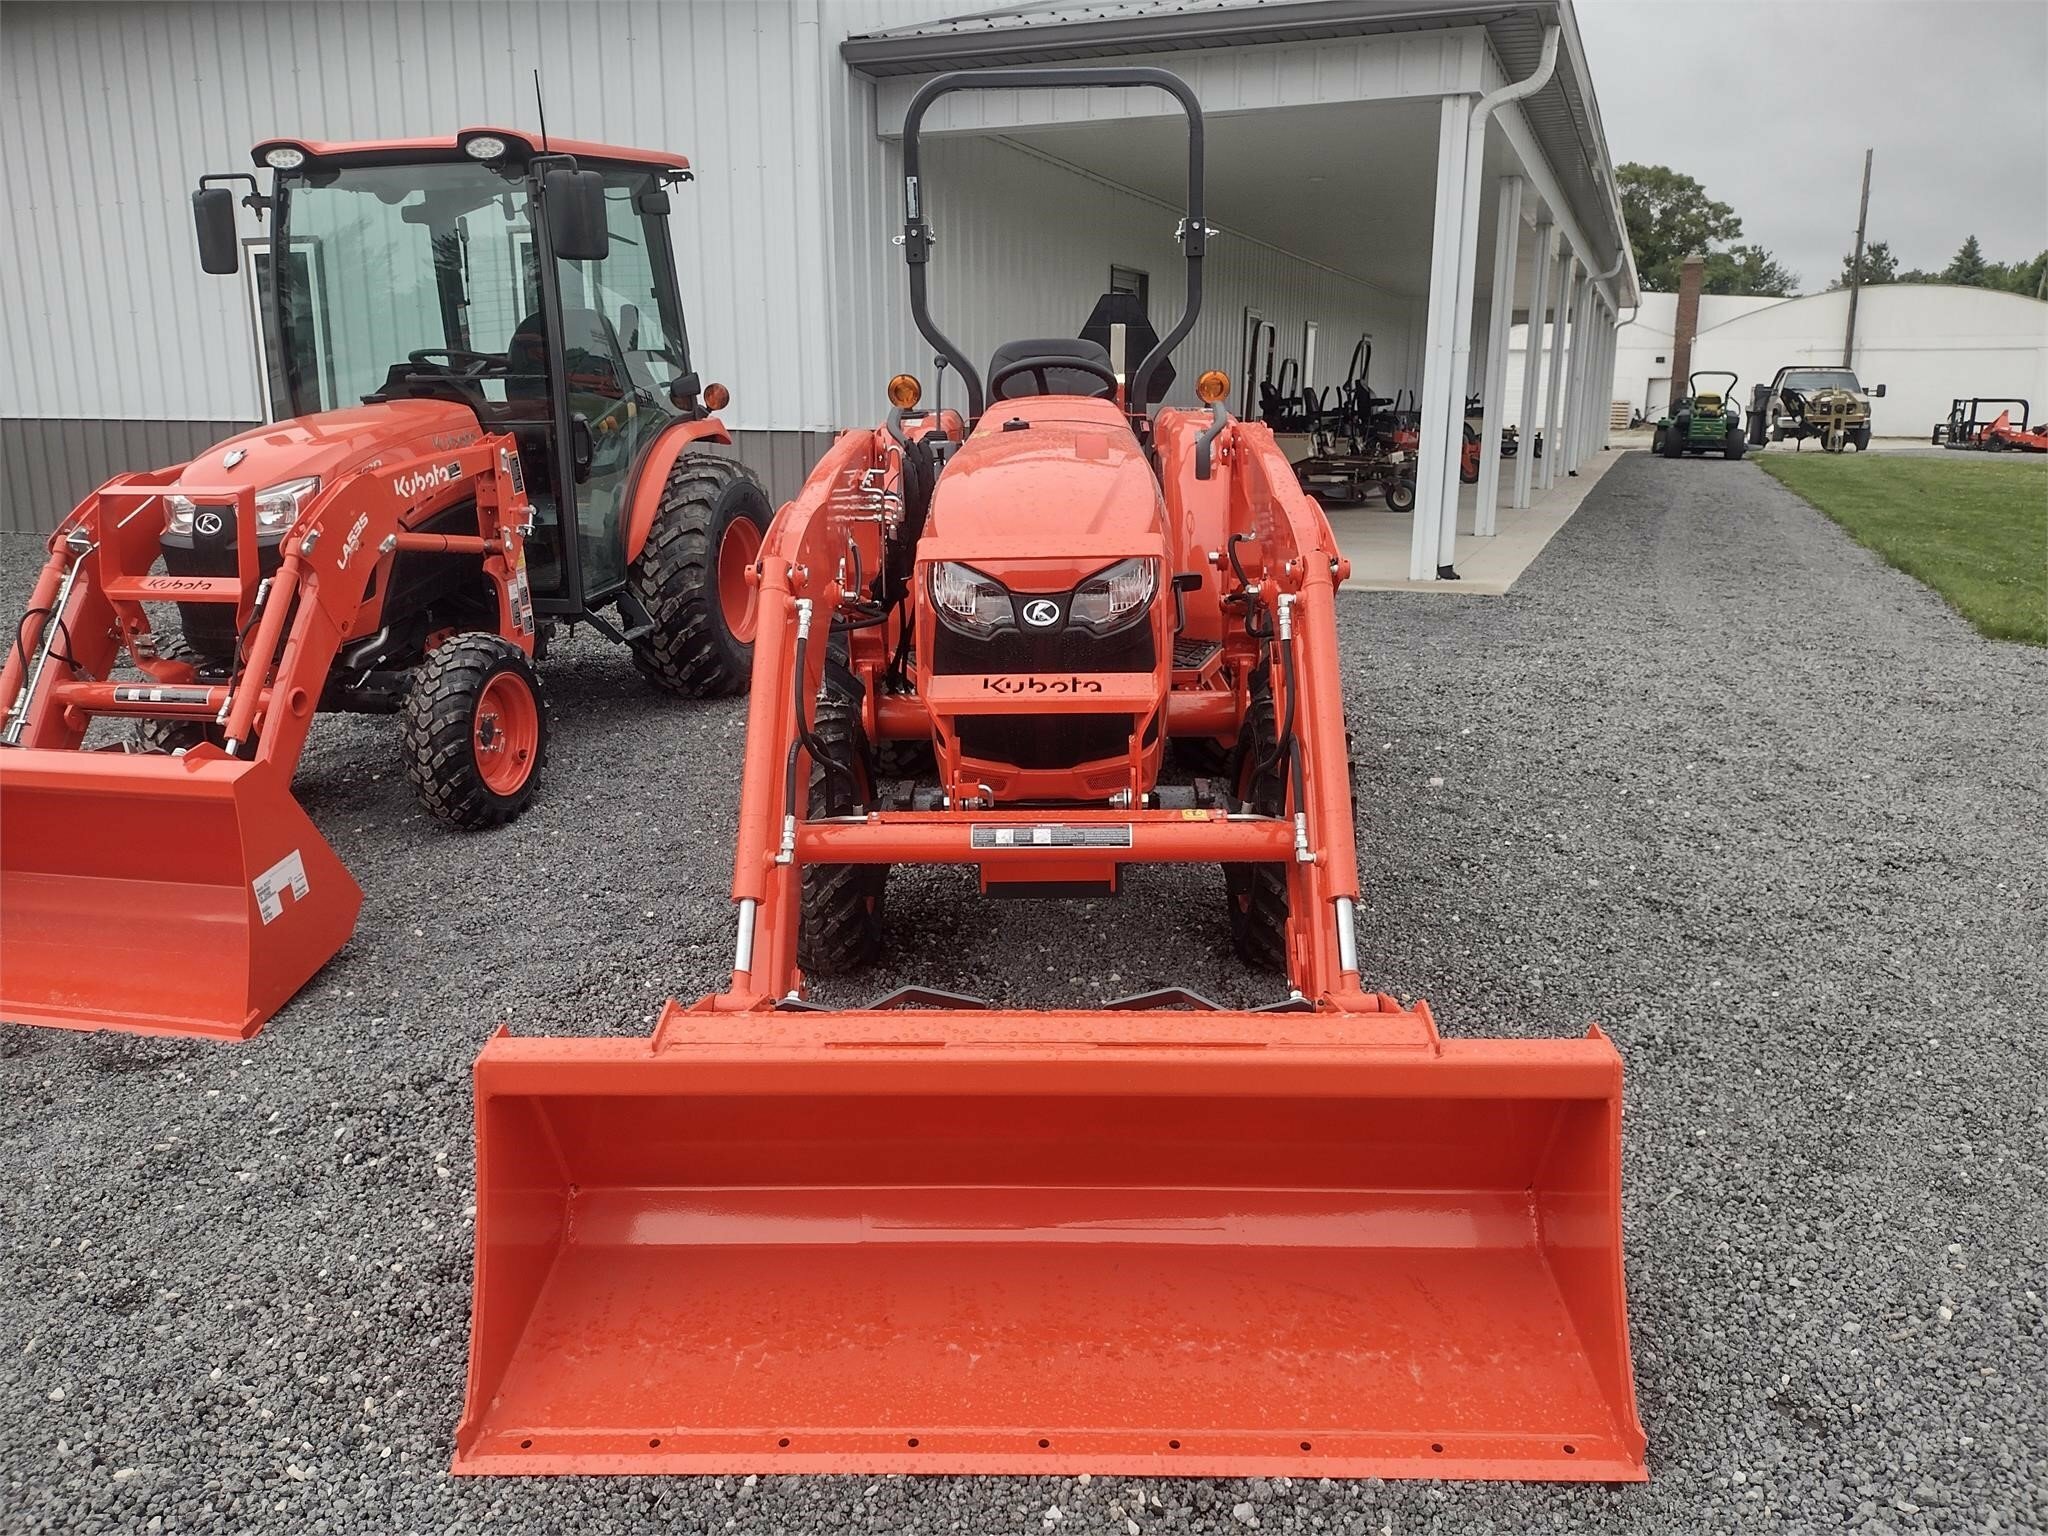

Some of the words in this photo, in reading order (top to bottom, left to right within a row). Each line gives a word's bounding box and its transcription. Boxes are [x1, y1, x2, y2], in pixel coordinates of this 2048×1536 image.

[393, 463, 450, 498] Kubota
[337, 511, 369, 570] LA535
[148, 580, 212, 591] Kubota
[983, 677, 1102, 694] Kubota
